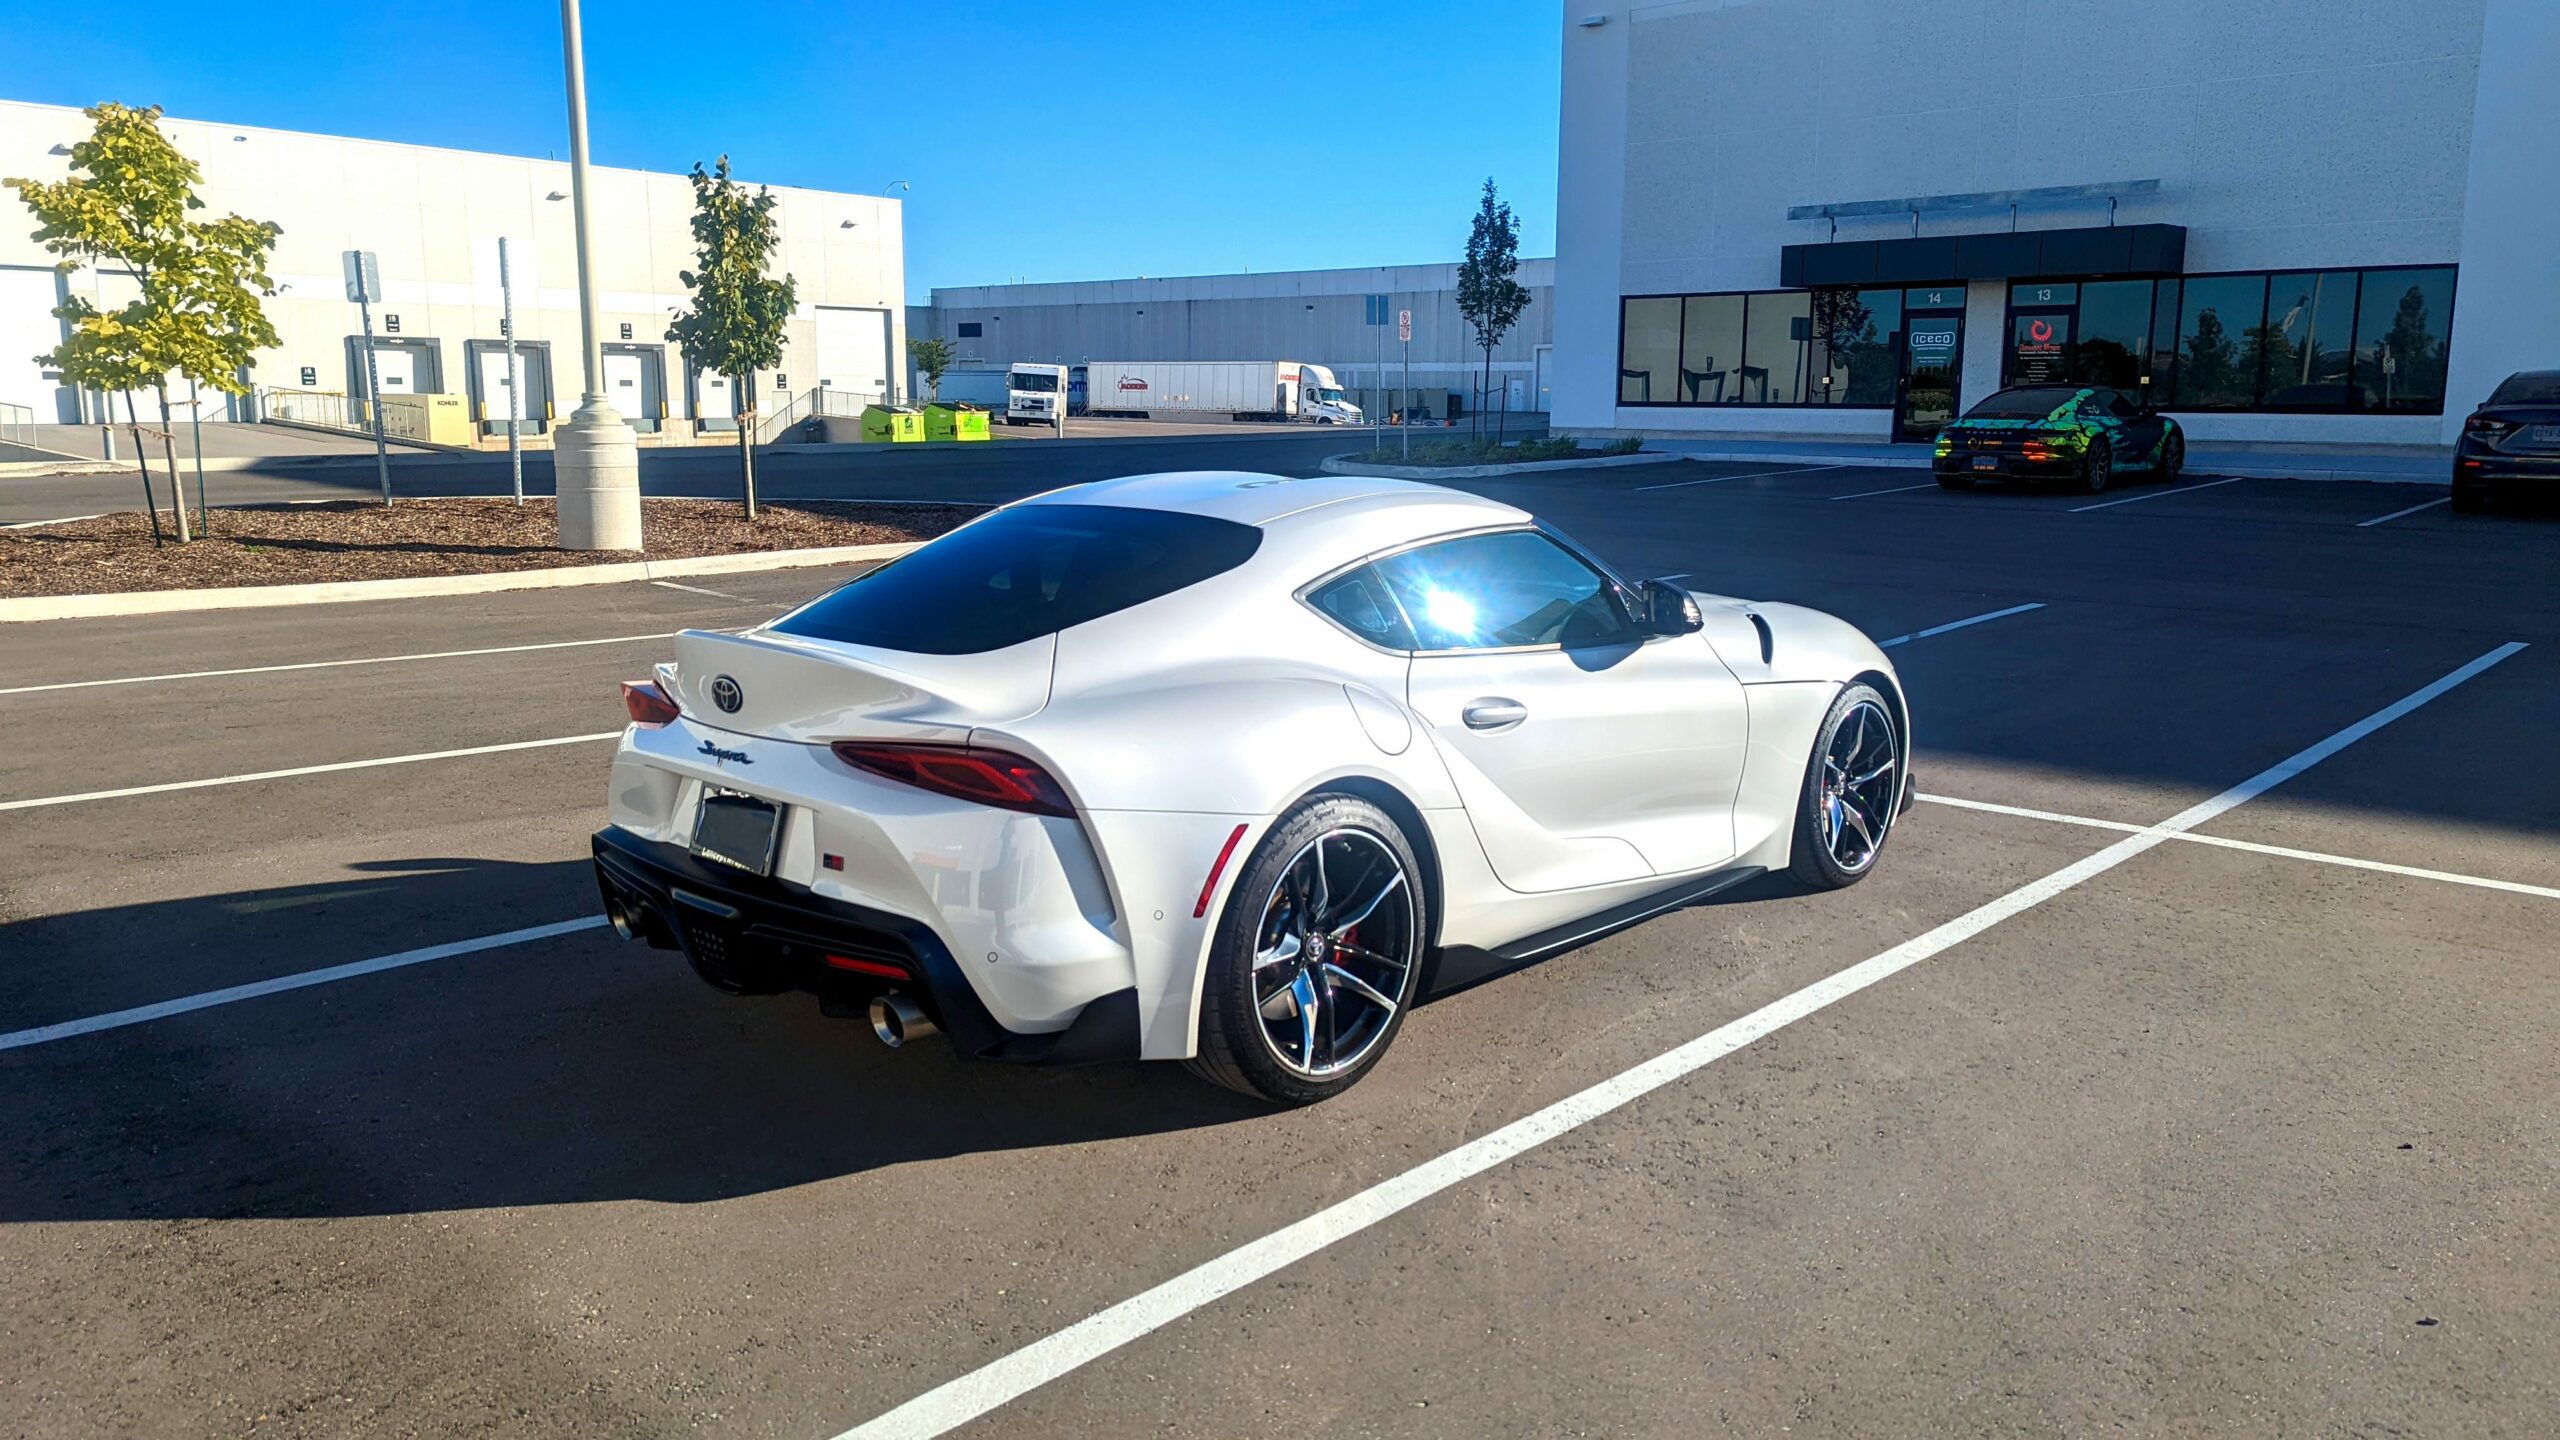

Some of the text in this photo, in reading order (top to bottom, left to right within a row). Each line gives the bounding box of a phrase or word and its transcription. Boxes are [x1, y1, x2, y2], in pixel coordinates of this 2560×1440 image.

[1928, 293, 1941, 304] 14
[2037, 289, 2051, 301] 13
[697, 740, 755, 766] Supra
[1270, 807, 1336, 862] Pilot Super Sport
